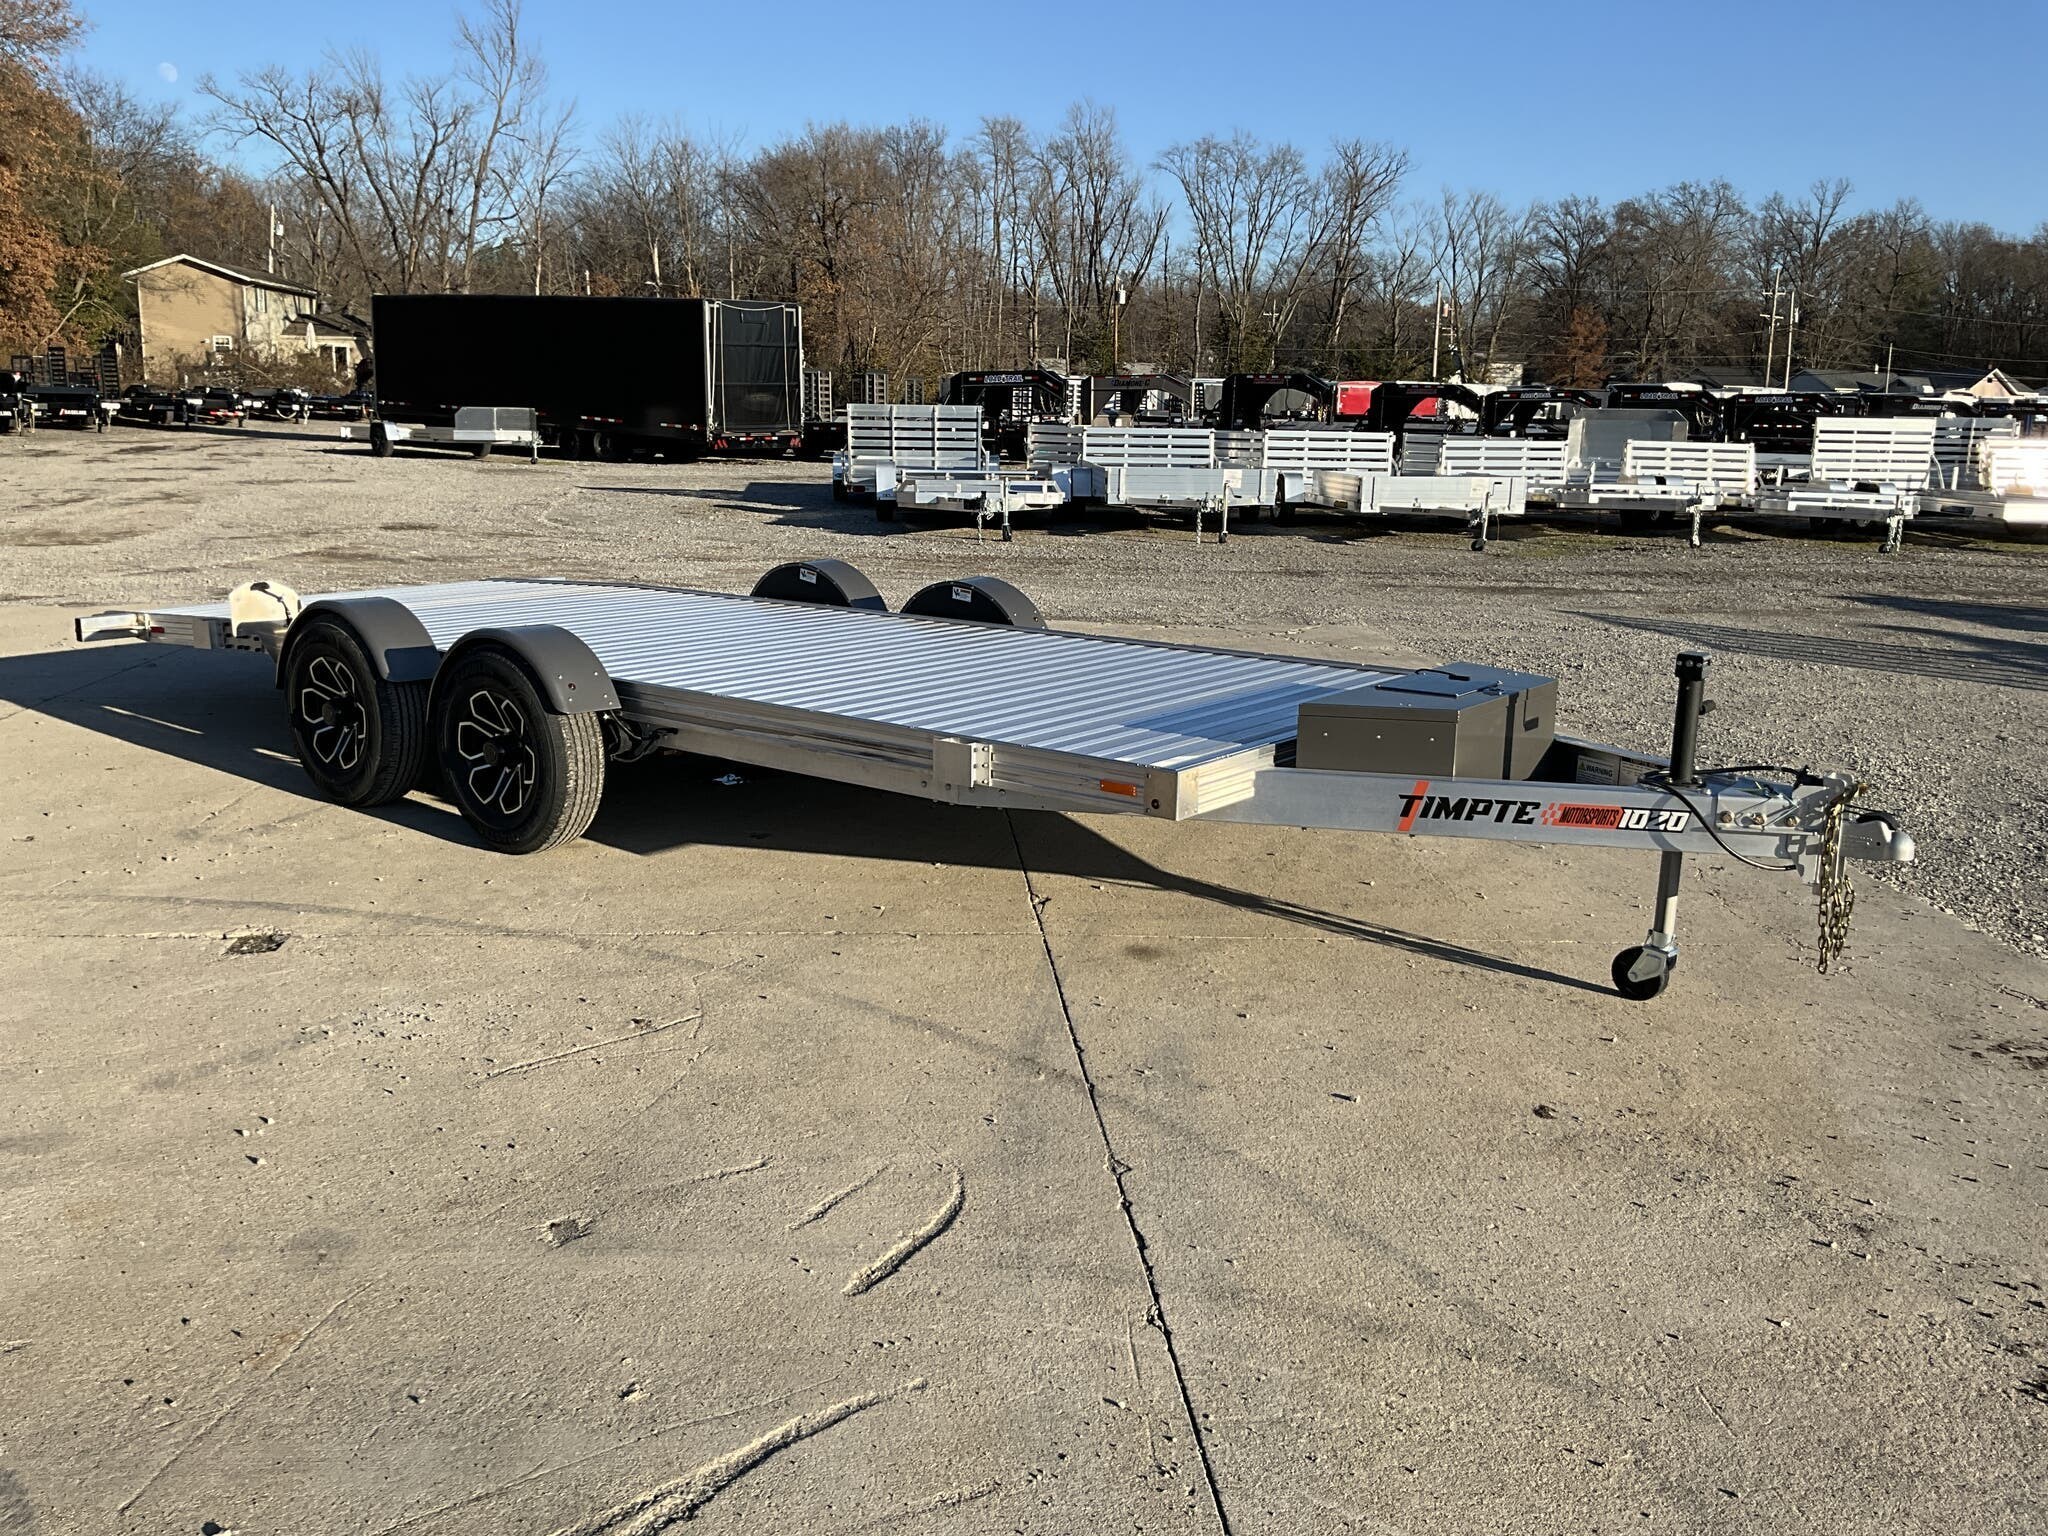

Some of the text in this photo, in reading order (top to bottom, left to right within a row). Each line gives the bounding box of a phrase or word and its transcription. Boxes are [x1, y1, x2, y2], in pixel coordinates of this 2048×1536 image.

[984, 375, 1001, 383] LOAD
[1585, 764, 1613, 777] WARNING
[1398, 795, 1690, 831] TIMPTE MOTORSPORTS 1020
